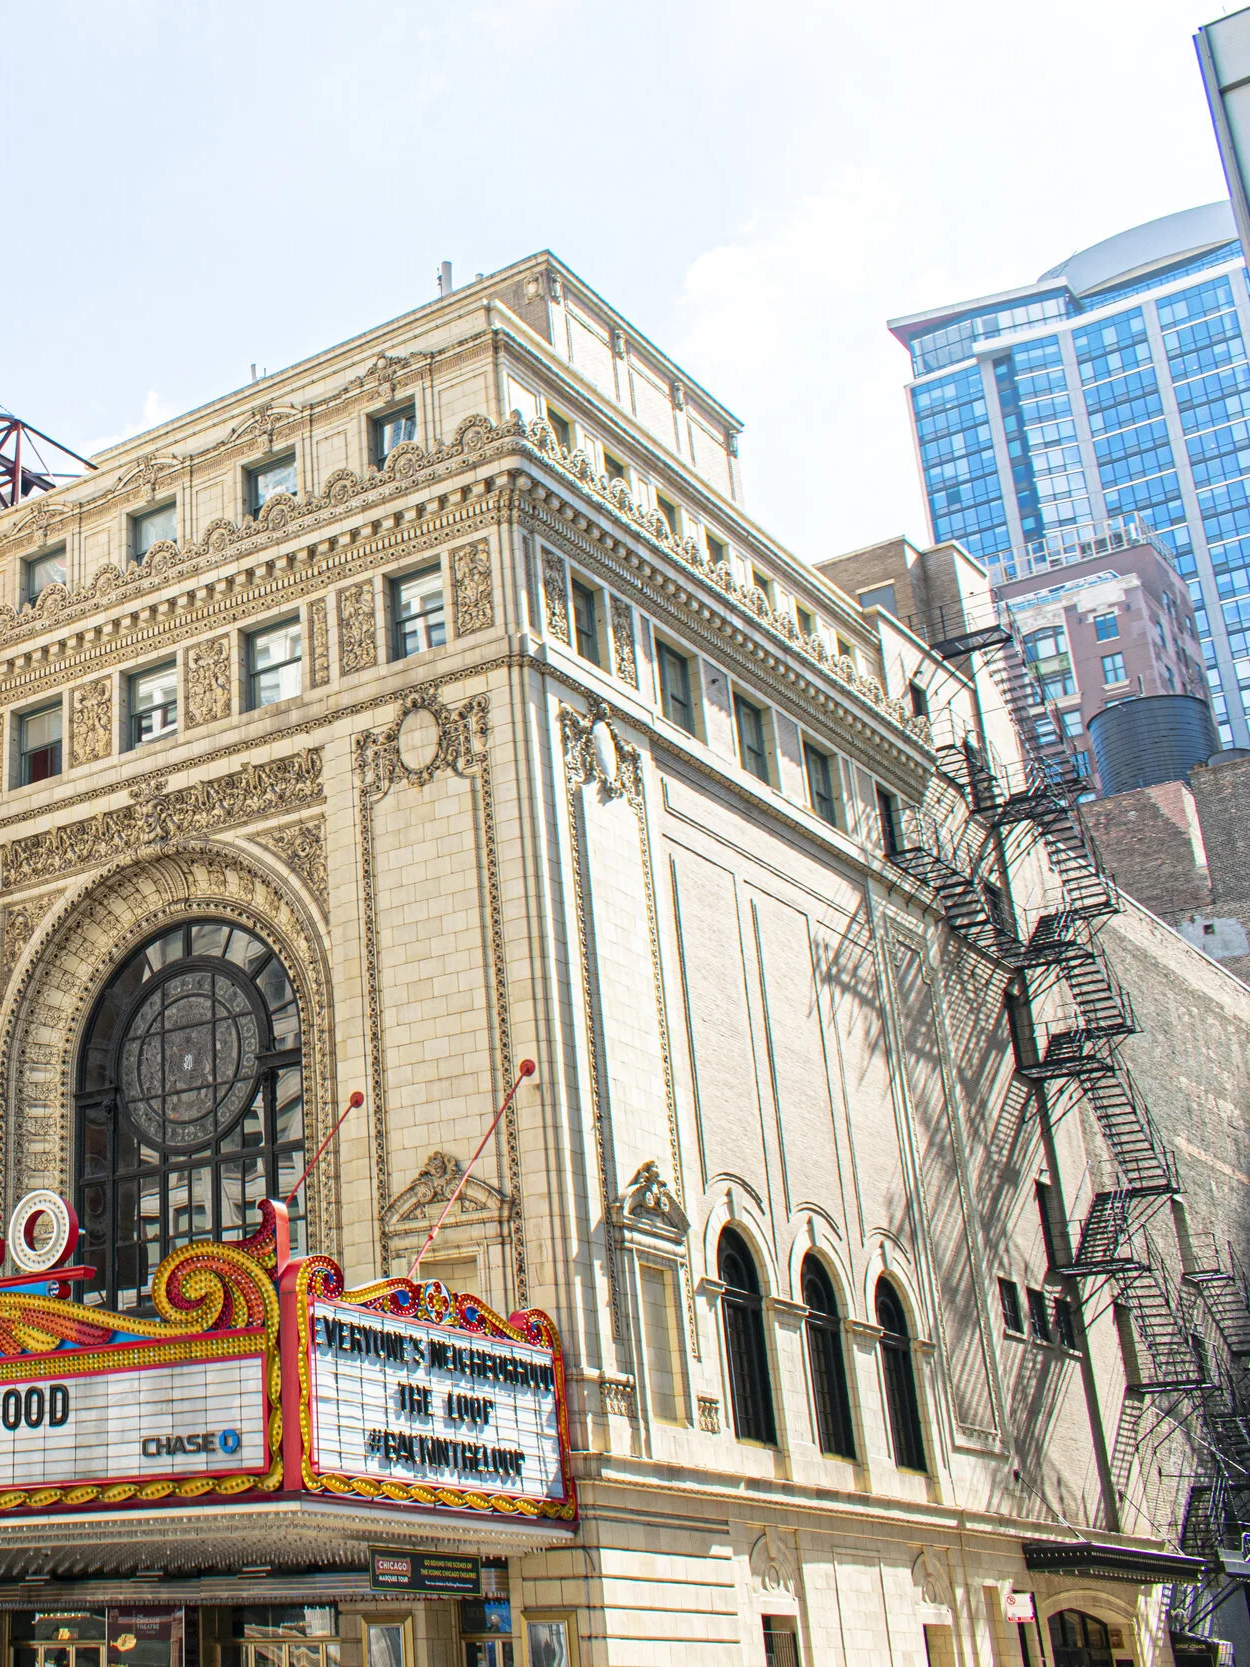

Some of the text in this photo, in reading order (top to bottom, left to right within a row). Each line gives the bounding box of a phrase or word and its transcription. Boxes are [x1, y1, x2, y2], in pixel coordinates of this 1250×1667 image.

[311, 1313, 426, 1366] EVERYONE'S
[398, 1380, 494, 1425] THE LOOP
[142, 1432, 216, 1457] CHASE
[368, 1428, 526, 1477] #BACKINTHELOOP
[378, 1560, 408, 1571] CHICAGO
[378, 1575, 398, 1583] MARQUEE
